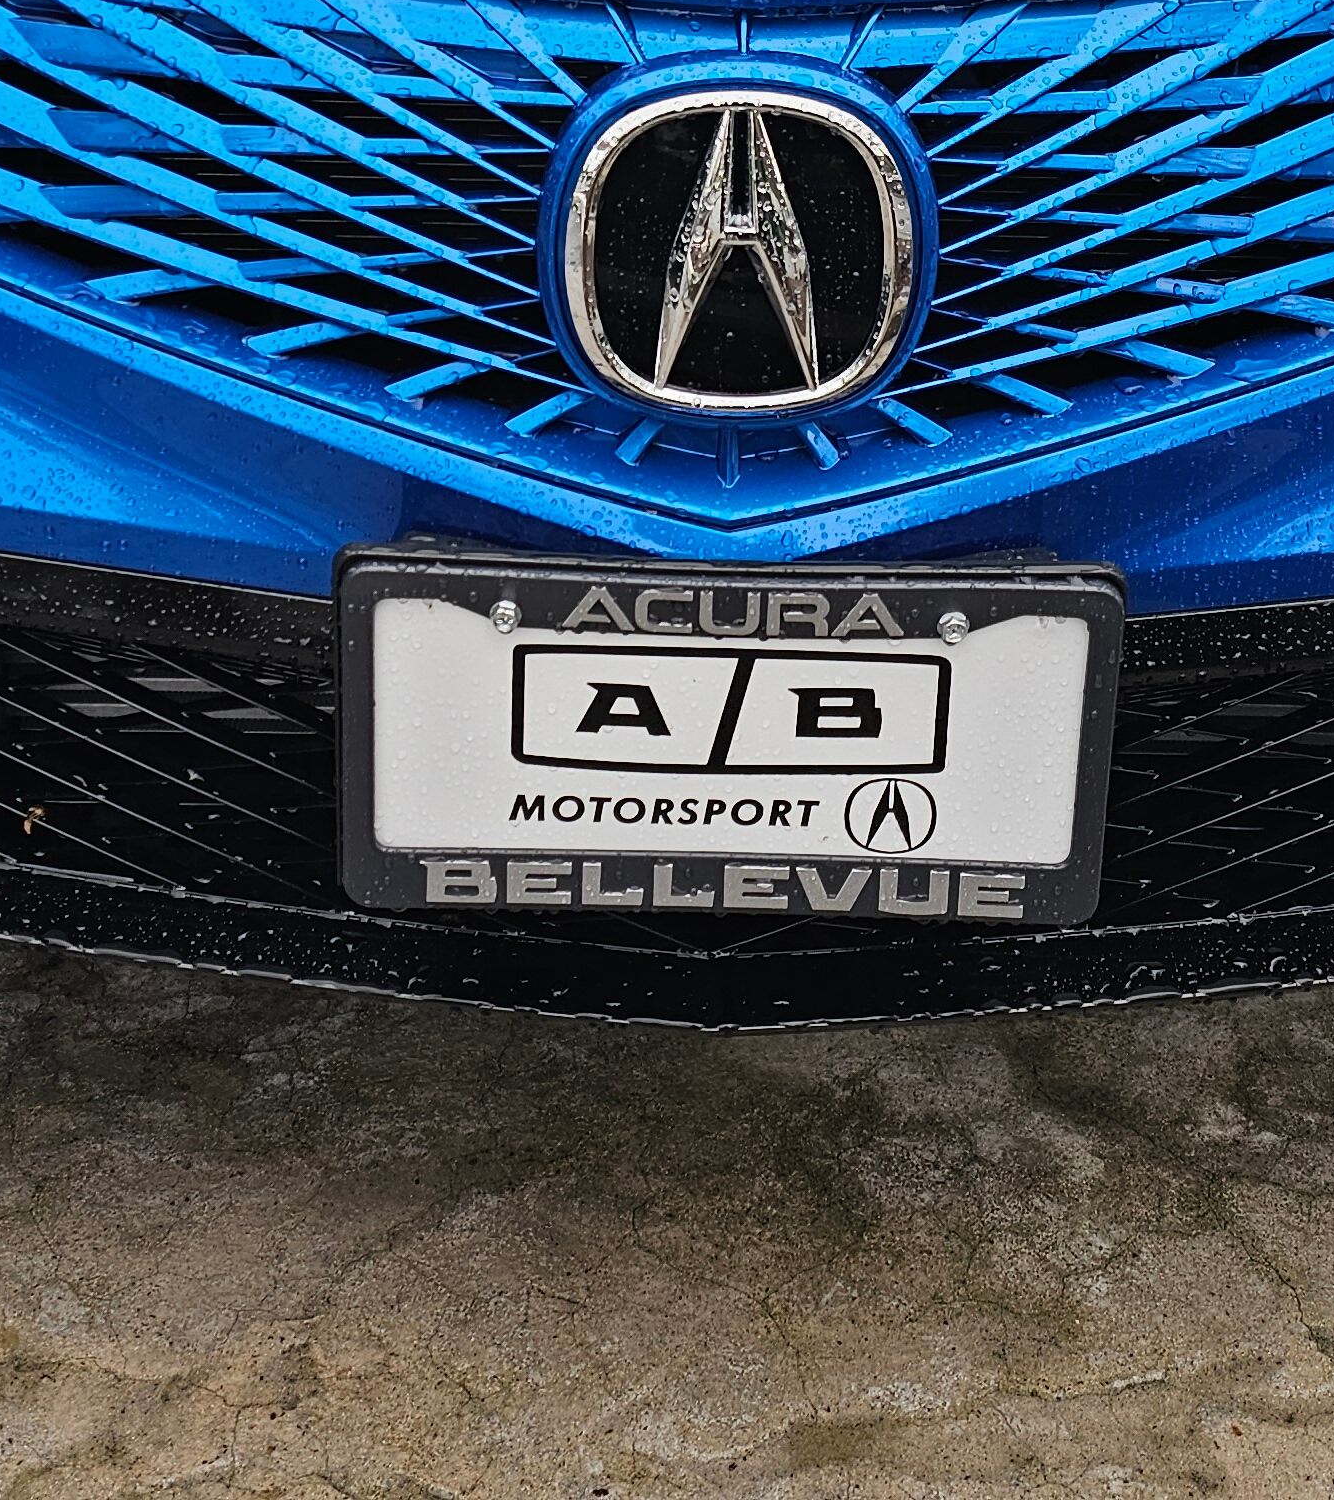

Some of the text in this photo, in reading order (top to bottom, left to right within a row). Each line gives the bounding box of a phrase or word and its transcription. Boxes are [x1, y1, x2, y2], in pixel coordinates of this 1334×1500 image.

[561, 584, 904, 640] ACURA
[575, 681, 883, 739] A B
[507, 793, 821, 828] MOTORSPORT
[418, 858, 1028, 920] BELLEVUE
